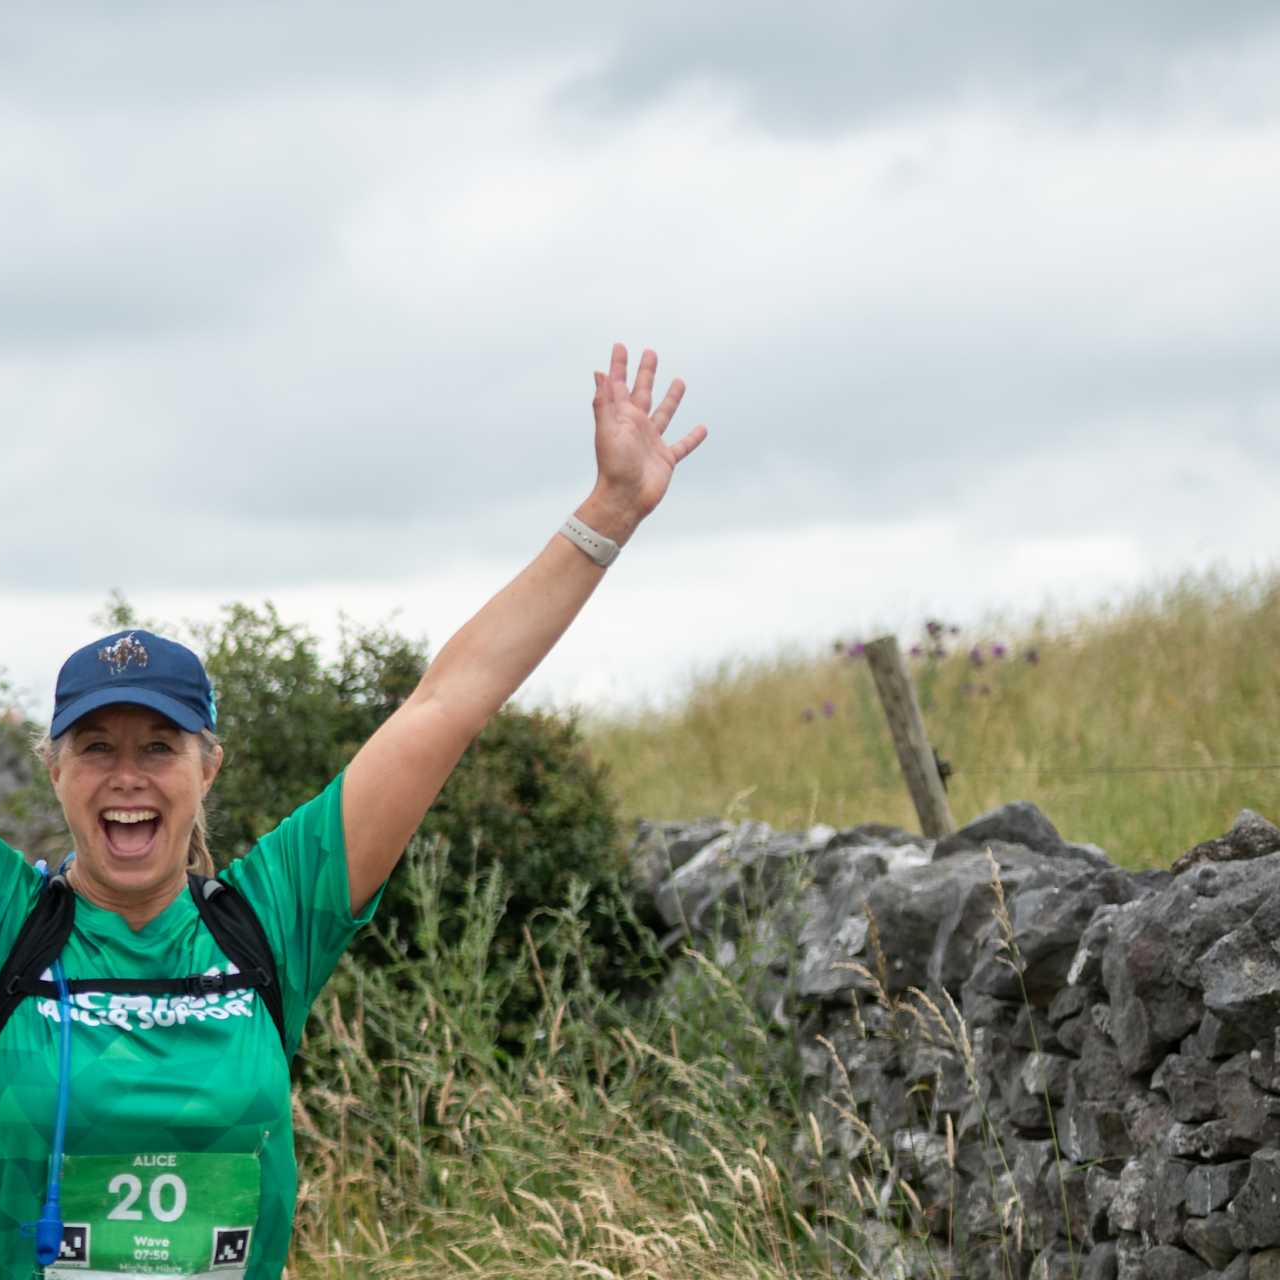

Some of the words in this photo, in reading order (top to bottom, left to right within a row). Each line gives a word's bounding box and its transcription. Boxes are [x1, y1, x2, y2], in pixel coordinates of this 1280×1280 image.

[133, 1155, 177, 1167] ALICE
[107, 1173, 188, 1223] 20
[134, 1235, 170, 1248] Wave
[134, 1249, 170, 1261] 07:50
